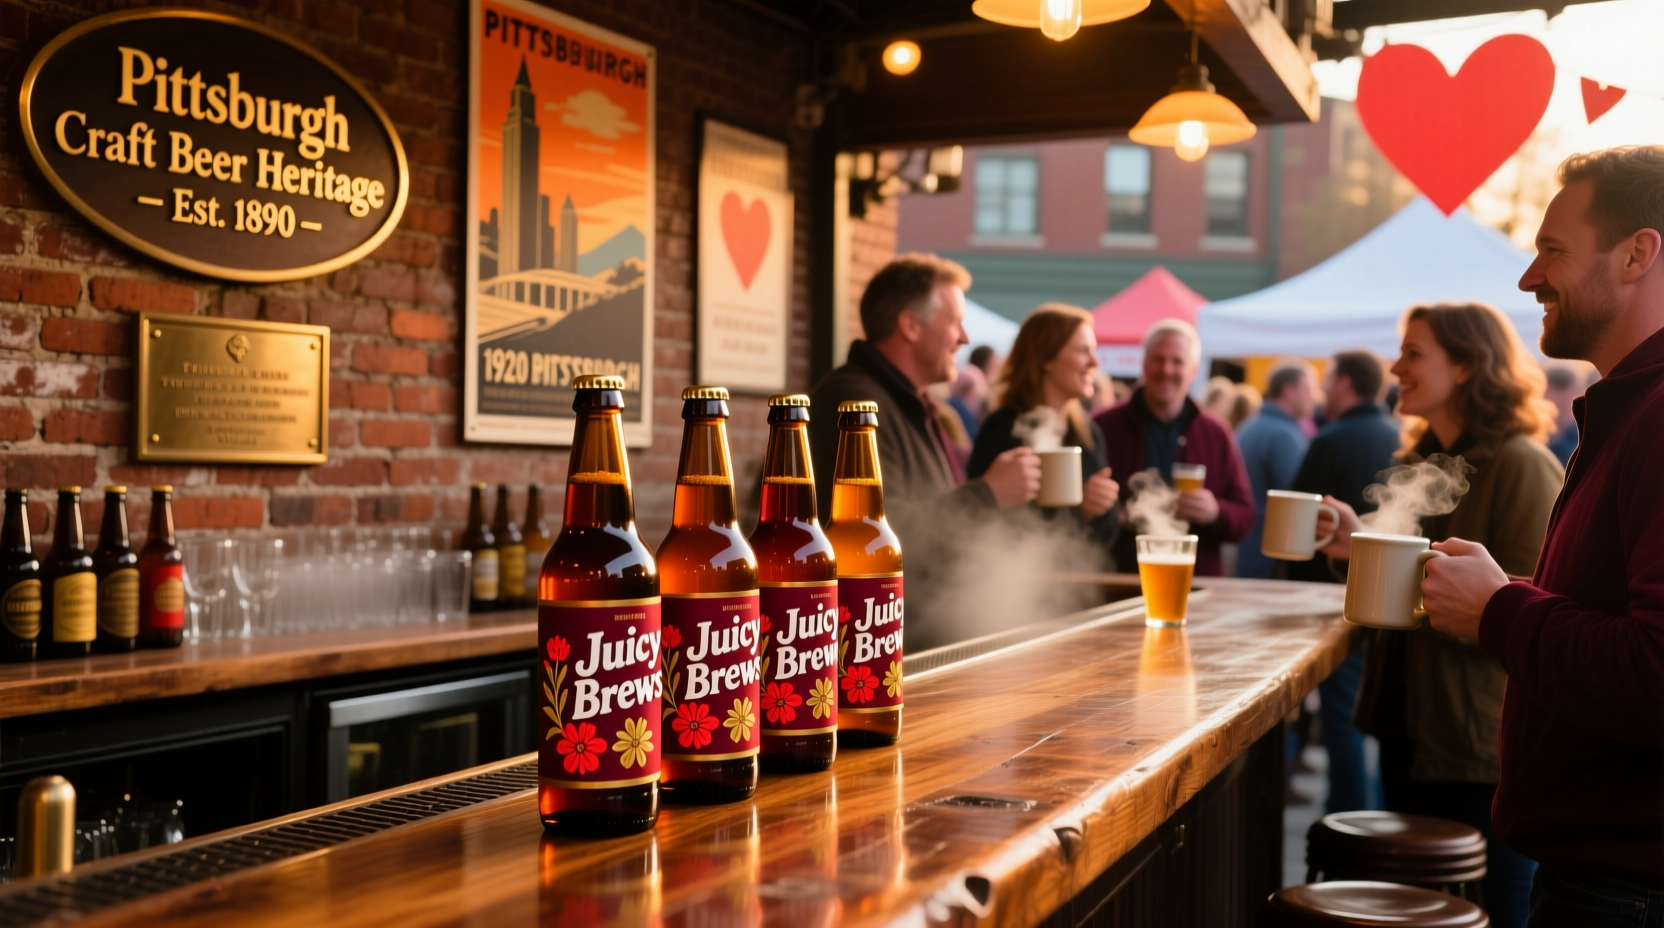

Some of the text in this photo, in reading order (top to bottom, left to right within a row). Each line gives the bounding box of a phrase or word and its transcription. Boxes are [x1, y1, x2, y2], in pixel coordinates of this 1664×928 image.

[117, 46, 350, 160] Pittsburgh
[55, 110, 385, 218] Craft Beer Heritage
[172, 188, 296, 238] Est. 1890
[483, 347, 529, 386] 1920
[686, 614, 760, 662] Juicy
[776, 602, 839, 645] Juicy
[575, 625, 662, 678] Juicy
[571, 670, 663, 720] Brews
[684, 656, 761, 700] Brews
